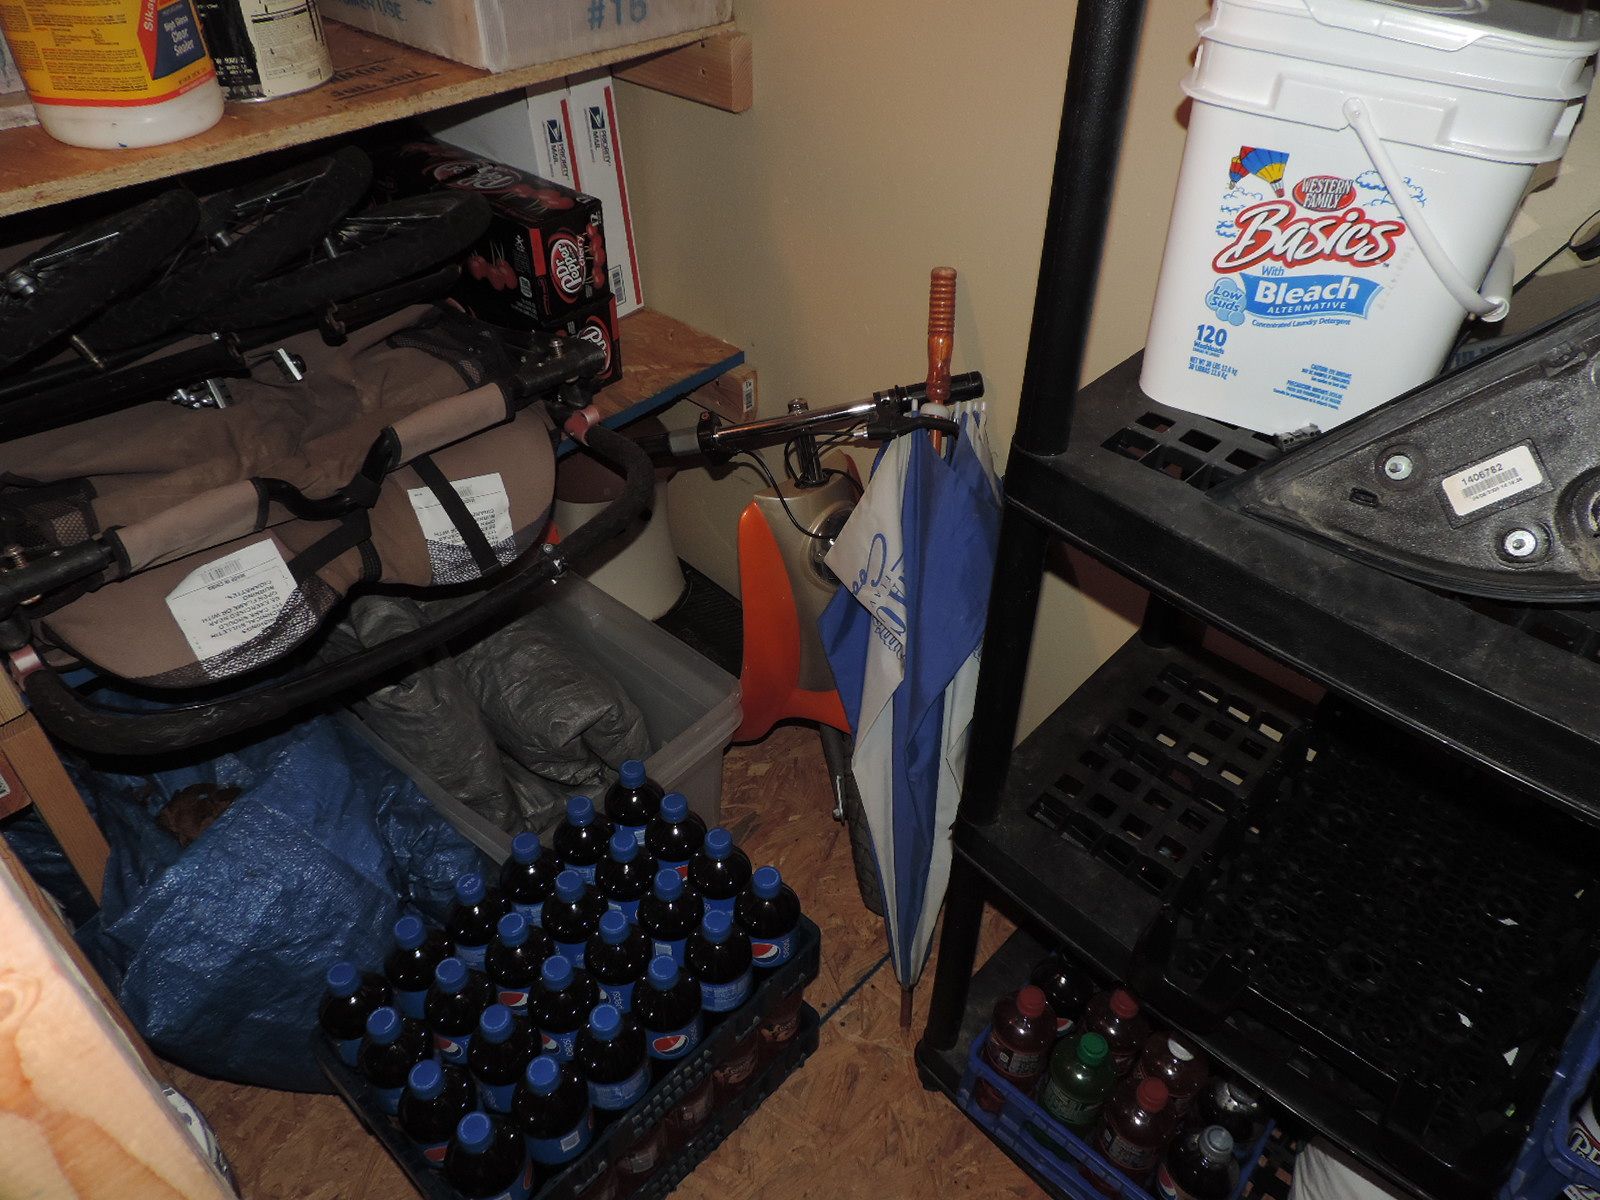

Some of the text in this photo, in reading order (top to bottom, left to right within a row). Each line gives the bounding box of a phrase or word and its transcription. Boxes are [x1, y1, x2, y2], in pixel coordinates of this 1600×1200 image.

[592, 131, 602, 151] MAIL
[1301, 178, 1354, 195] WESTERN
[1302, 192, 1342, 209] FAMILY
[1213, 201, 1405, 272] Basics
[558, 244, 583, 294] Pepper
[1261, 265, 1285, 277] With
[1213, 284, 1243, 301] Low
[1254, 277, 1361, 306] Bleach
[1210, 296, 1241, 313] Suds
[1266, 301, 1347, 315] ALTERNATIVE
[1252, 317, 1351, 329] Concentrated Laundry Detergent
[1196, 324, 1228, 347] 120
